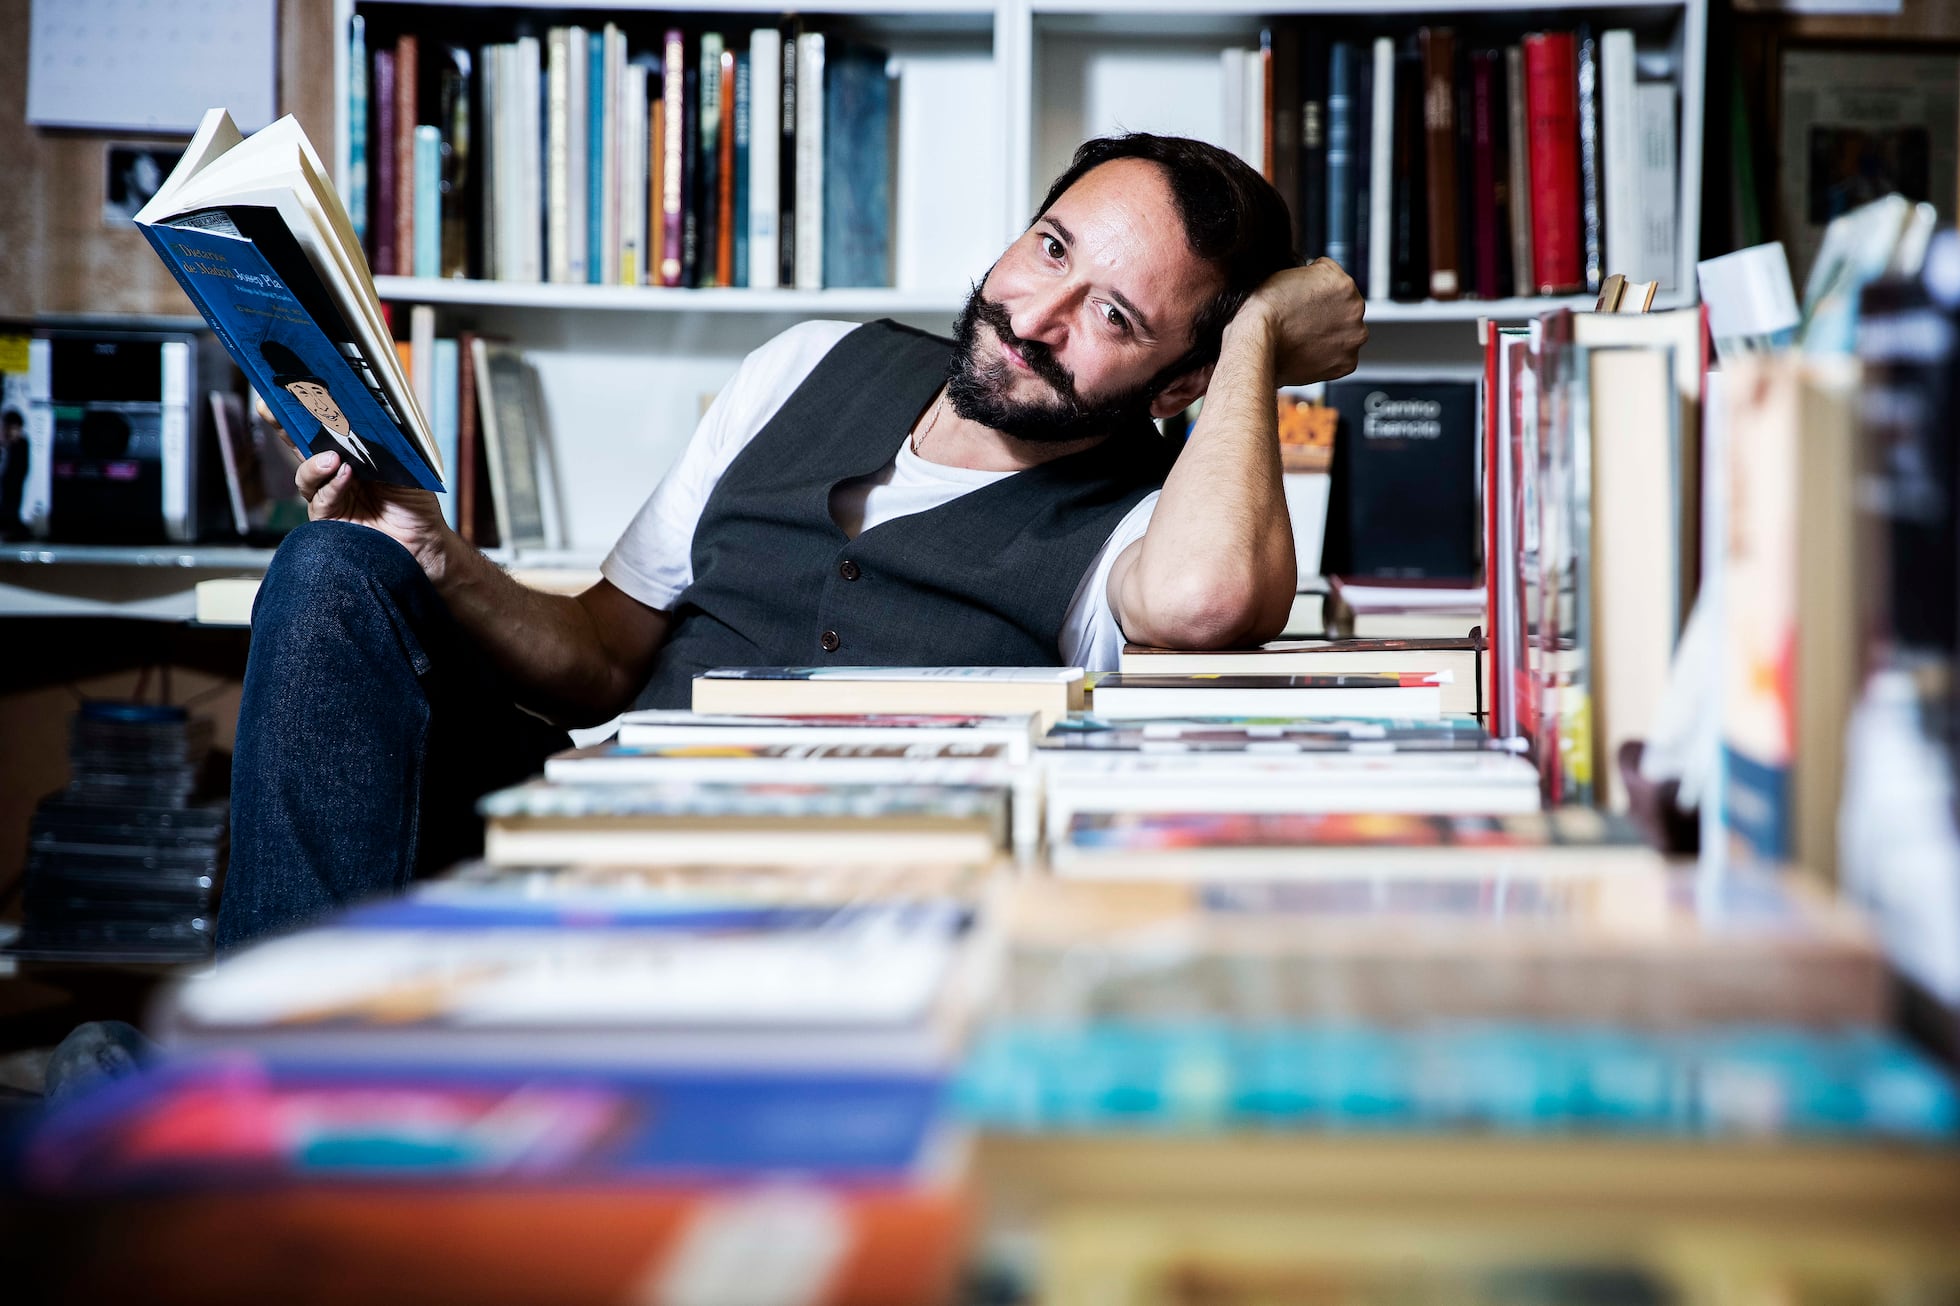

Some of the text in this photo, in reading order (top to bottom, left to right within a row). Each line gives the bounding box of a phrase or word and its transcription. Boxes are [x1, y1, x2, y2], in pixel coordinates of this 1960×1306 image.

[178, 244, 227, 262] Dietario
[183, 261, 198, 273] de
[194, 261, 236, 279] Madrid
[232, 268, 284, 289] Josep Pla
